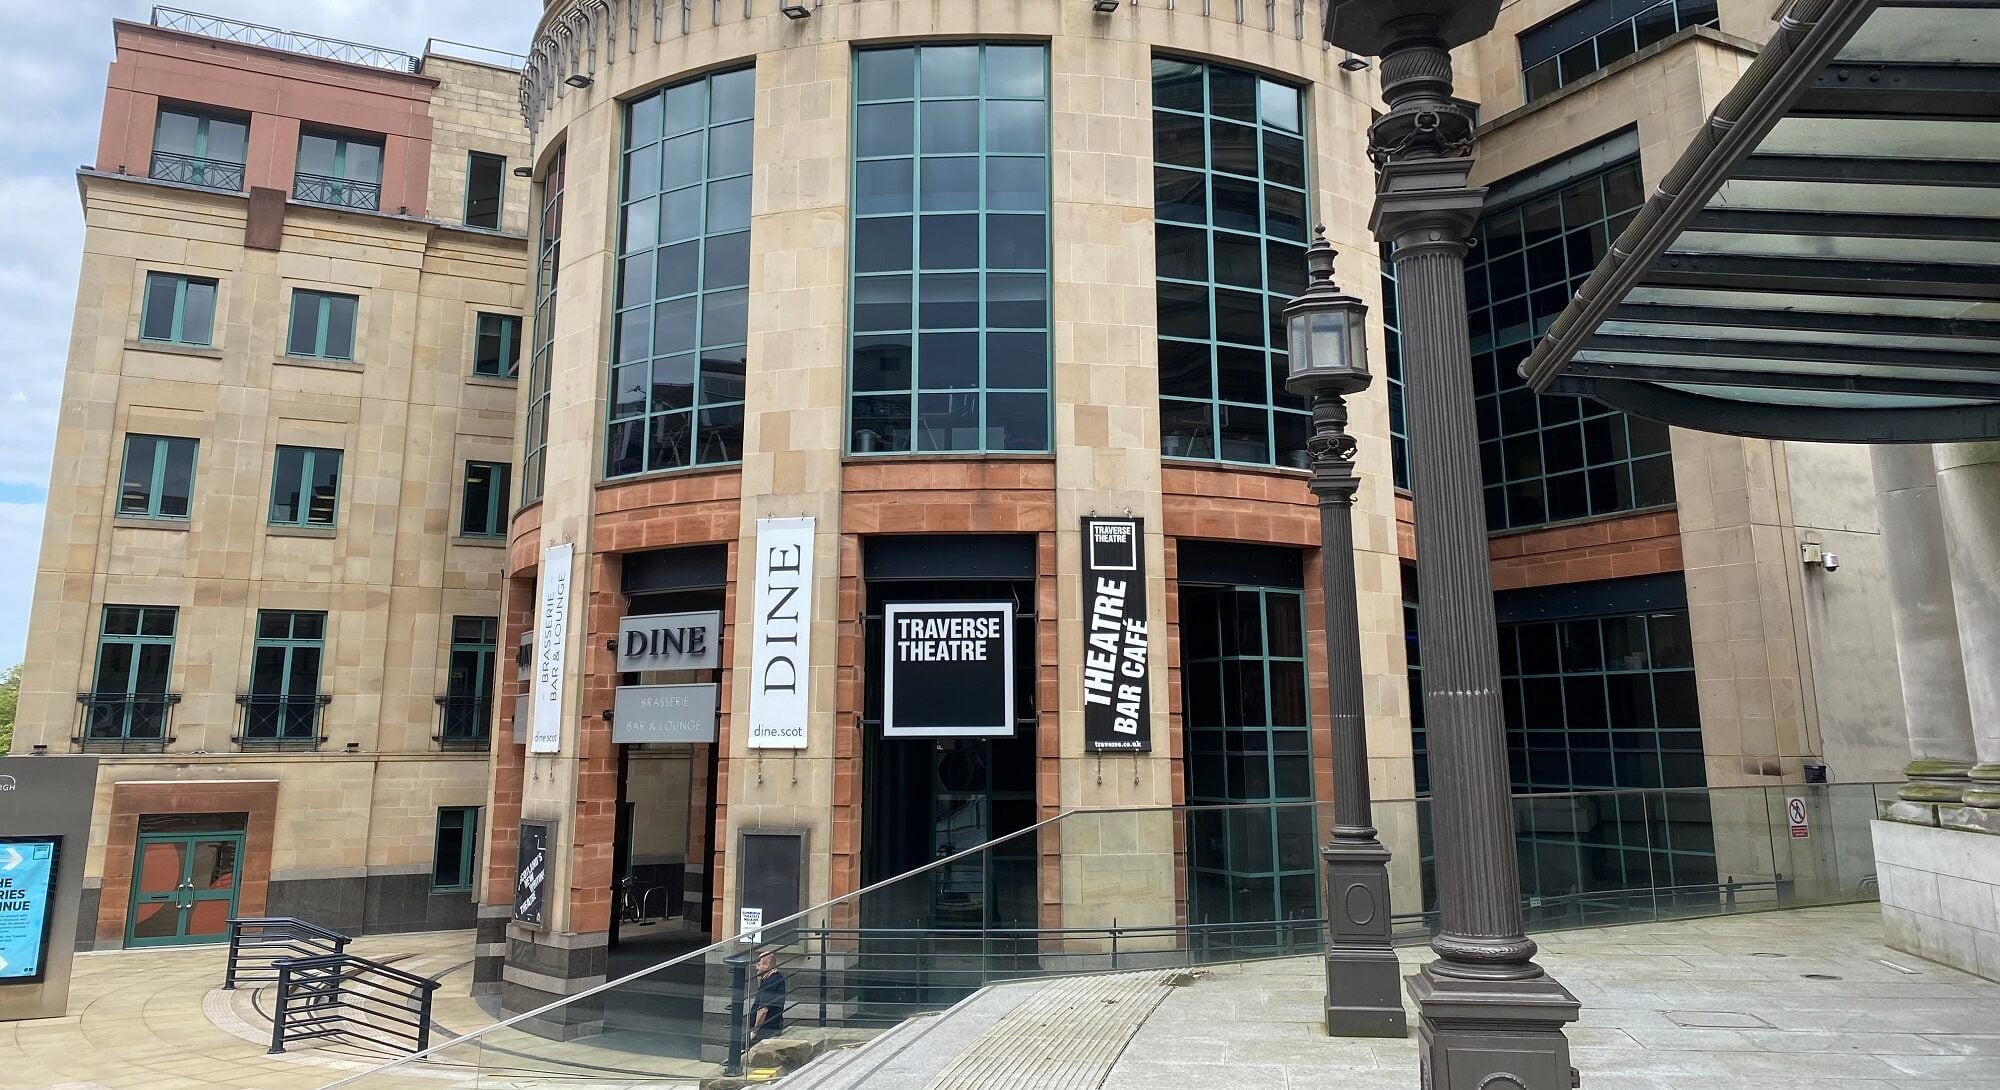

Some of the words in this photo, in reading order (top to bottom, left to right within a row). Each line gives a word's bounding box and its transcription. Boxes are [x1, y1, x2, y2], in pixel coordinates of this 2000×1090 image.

[1094, 526, 1132, 535] TRAVERSE
[1094, 534, 1127, 543] THEATRE
[553, 572, 566, 646] LOUNGE
[763, 543, 801, 696] DINE
[541, 592, 555, 683] BRASSERIE
[897, 617, 1000, 639] TRAVERSE
[624, 626, 707, 657] DINE
[897, 640, 987, 661] THEATRE
[1084, 576, 1127, 706] THEATRE
[1120, 617, 1148, 679] CAFÉ
[552, 651, 560, 662] &
[549, 667, 559, 701] BAR
[641, 696, 689, 708] BRASSERIE
[1113, 684, 1142, 735] BAR
[626, 721, 646, 732] BAR
[659, 720, 702, 731] LOUNGE
[754, 723, 803, 737] dine.scot
[1094, 740, 1142, 748] traverse.co.uk
